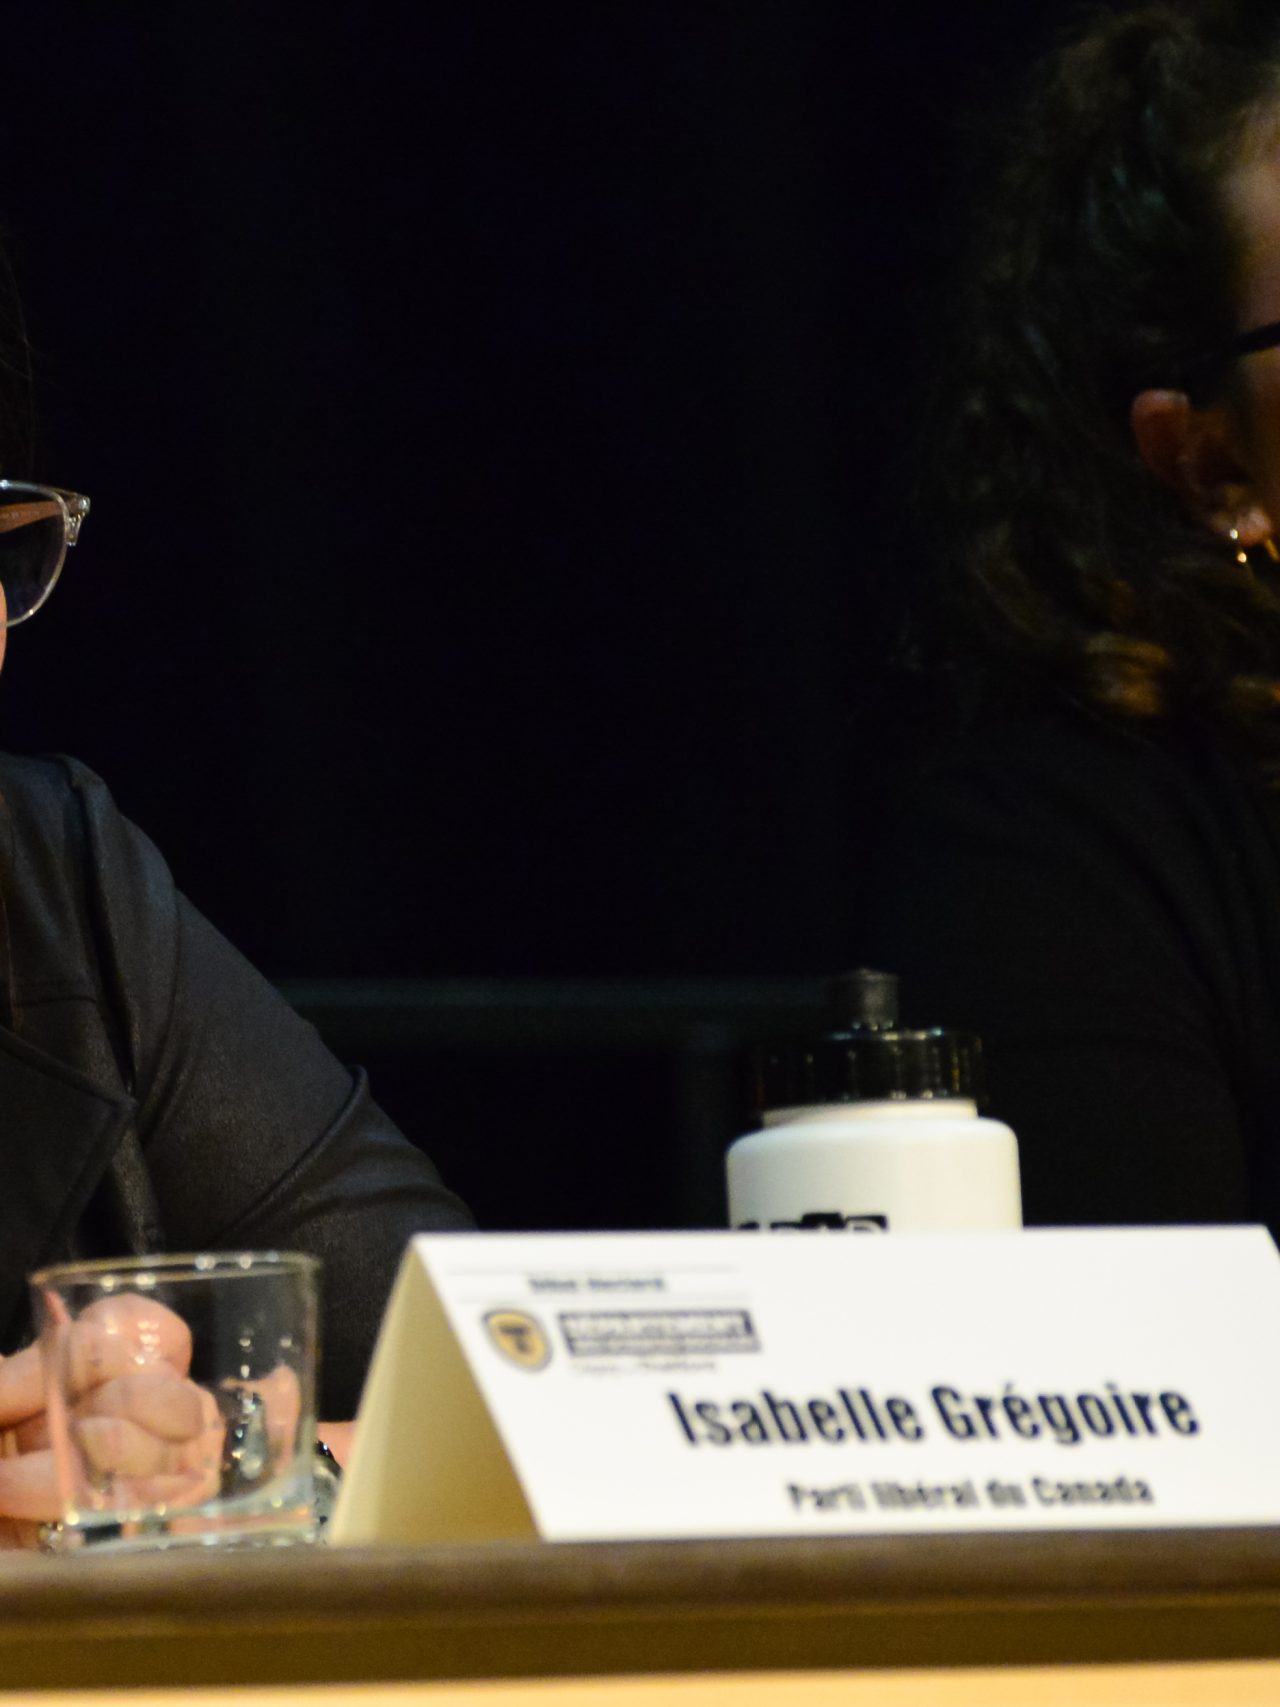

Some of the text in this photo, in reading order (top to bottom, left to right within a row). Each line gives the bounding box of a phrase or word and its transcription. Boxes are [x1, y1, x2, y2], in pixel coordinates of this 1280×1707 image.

[667, 1380, 1198, 1447] Isabelle Grégoire
[787, 1482, 866, 1512] Parti
[986, 1481, 1027, 1508] du
[1031, 1477, 1154, 1508] Canada
